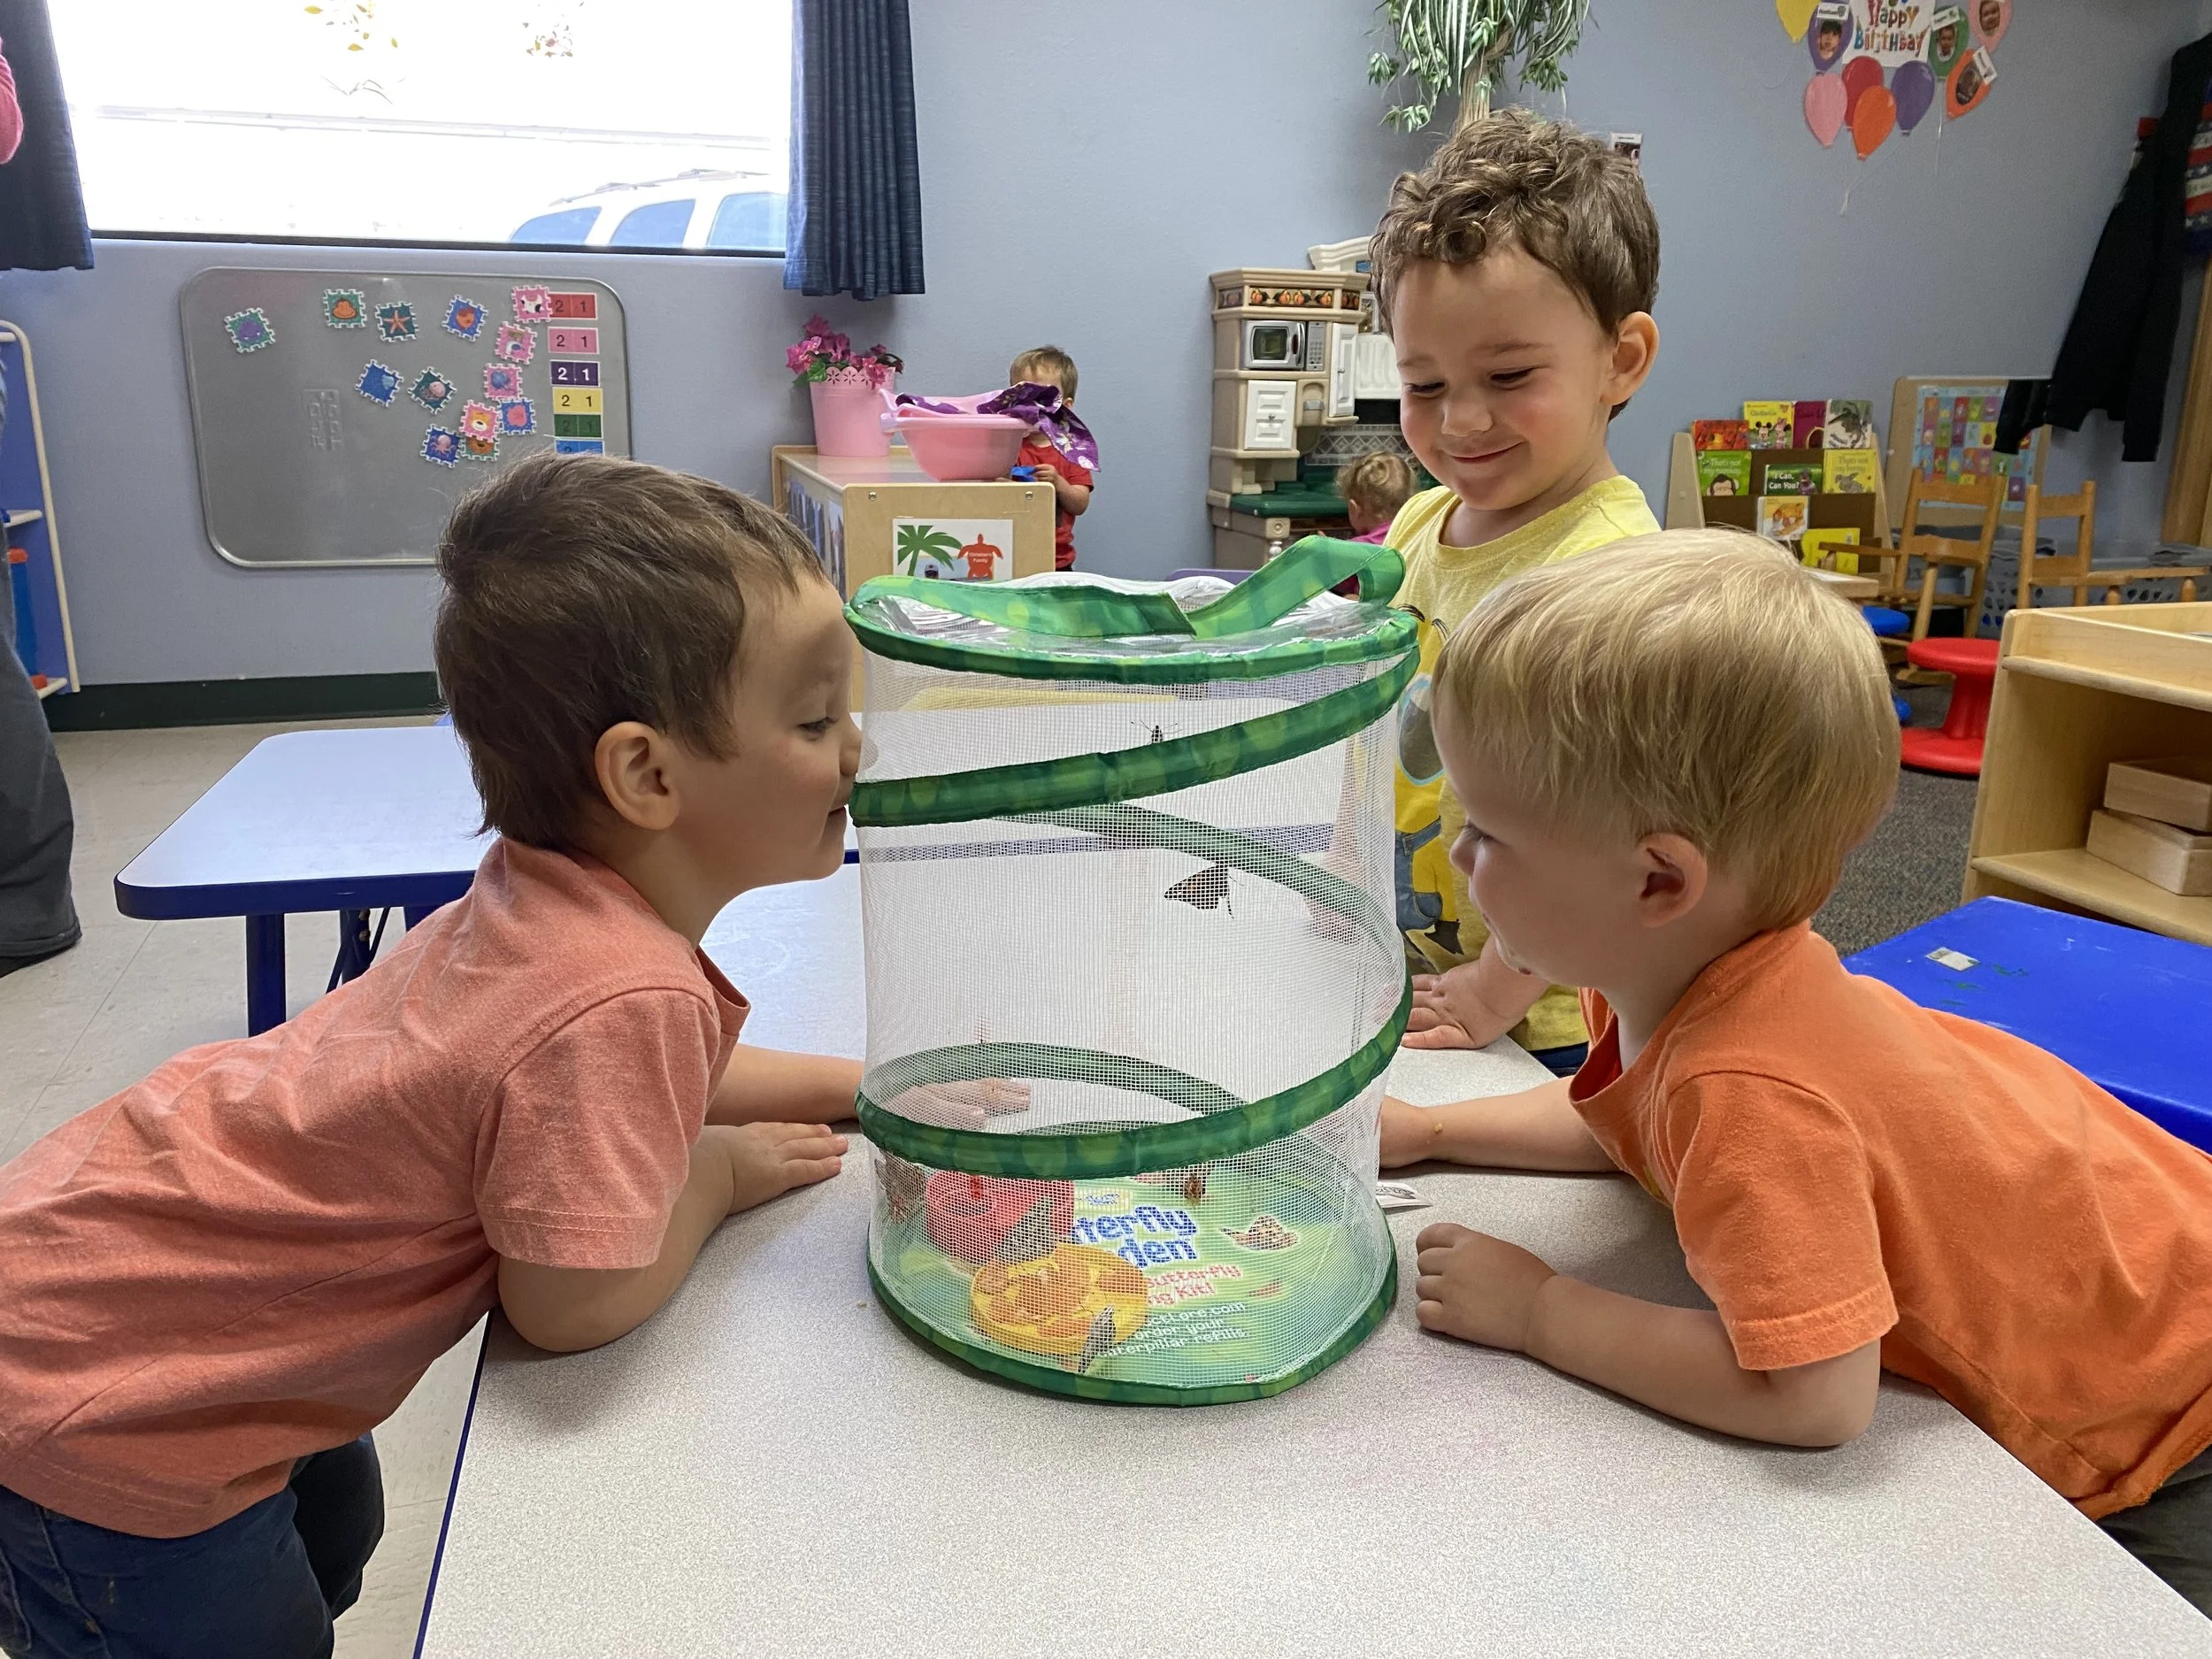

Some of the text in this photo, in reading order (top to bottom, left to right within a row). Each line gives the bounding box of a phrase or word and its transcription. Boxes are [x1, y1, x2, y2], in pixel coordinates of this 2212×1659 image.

[555, 299, 587, 313] 2 1
[556, 334, 588, 348] 2 1
[557, 366, 590, 381] 2 1
[561, 395, 593, 408] 2 1
[1175, 1281, 1216, 1299] Kit!
[1185, 1318, 1225, 1335] your
